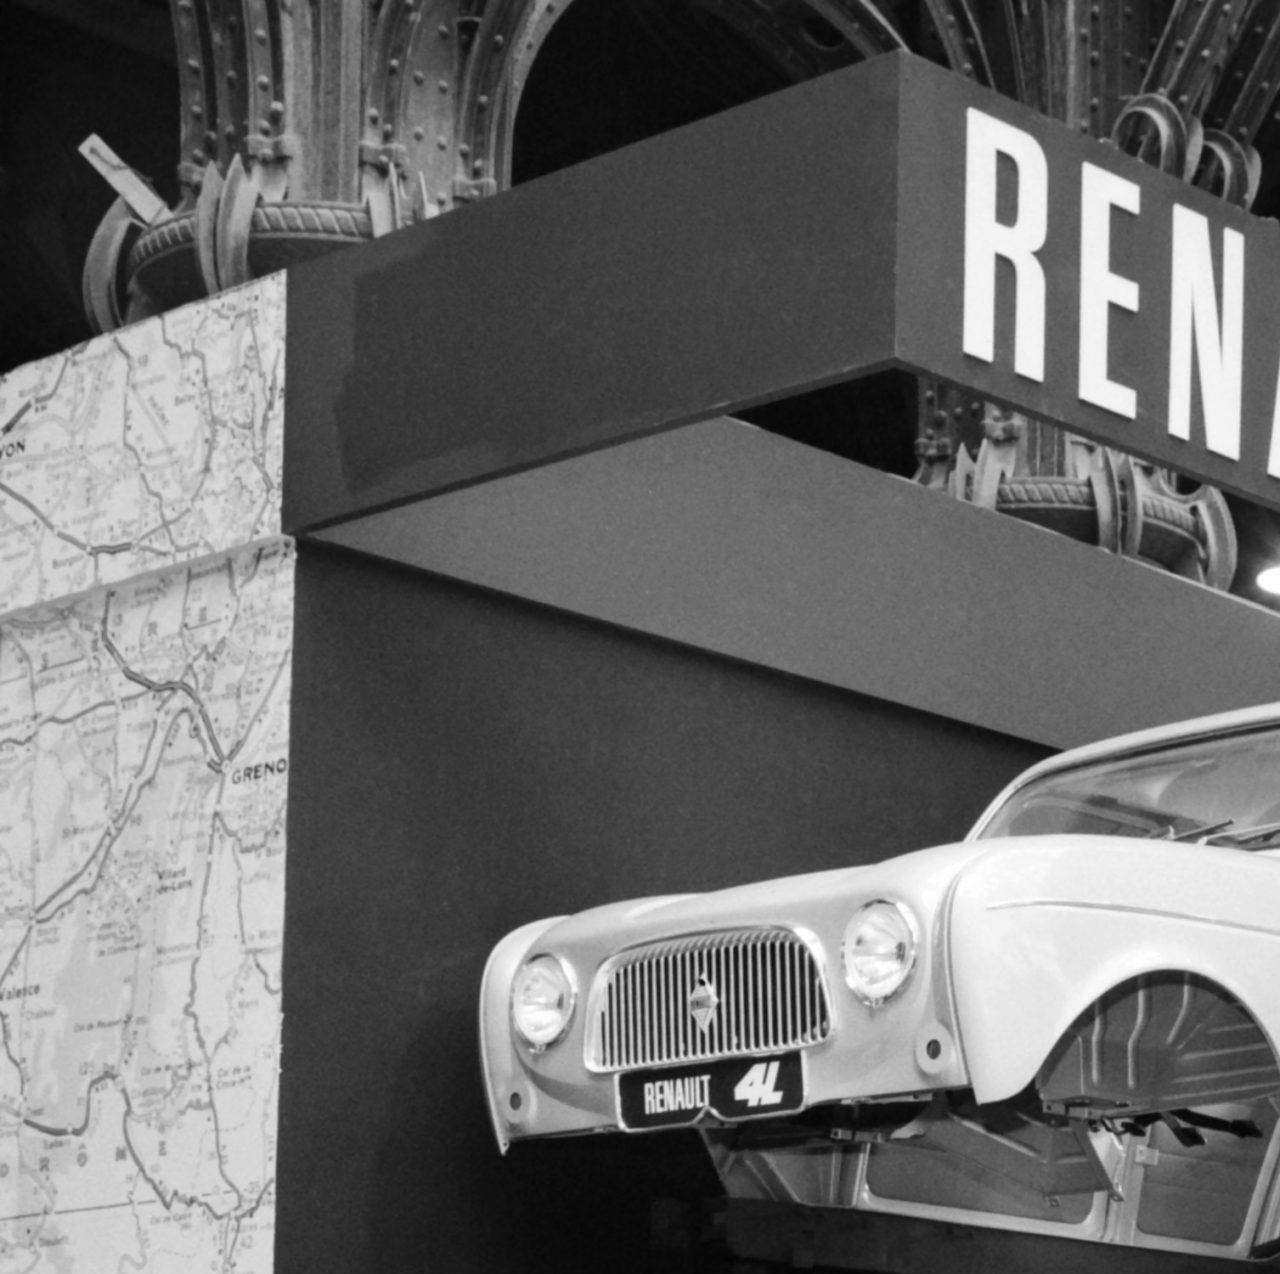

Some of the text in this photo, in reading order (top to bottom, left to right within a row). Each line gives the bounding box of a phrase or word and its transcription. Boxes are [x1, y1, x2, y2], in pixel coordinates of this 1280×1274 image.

[232, 758, 287, 785] GRENO
[644, 1061, 783, 1115] RENAULT 4L
